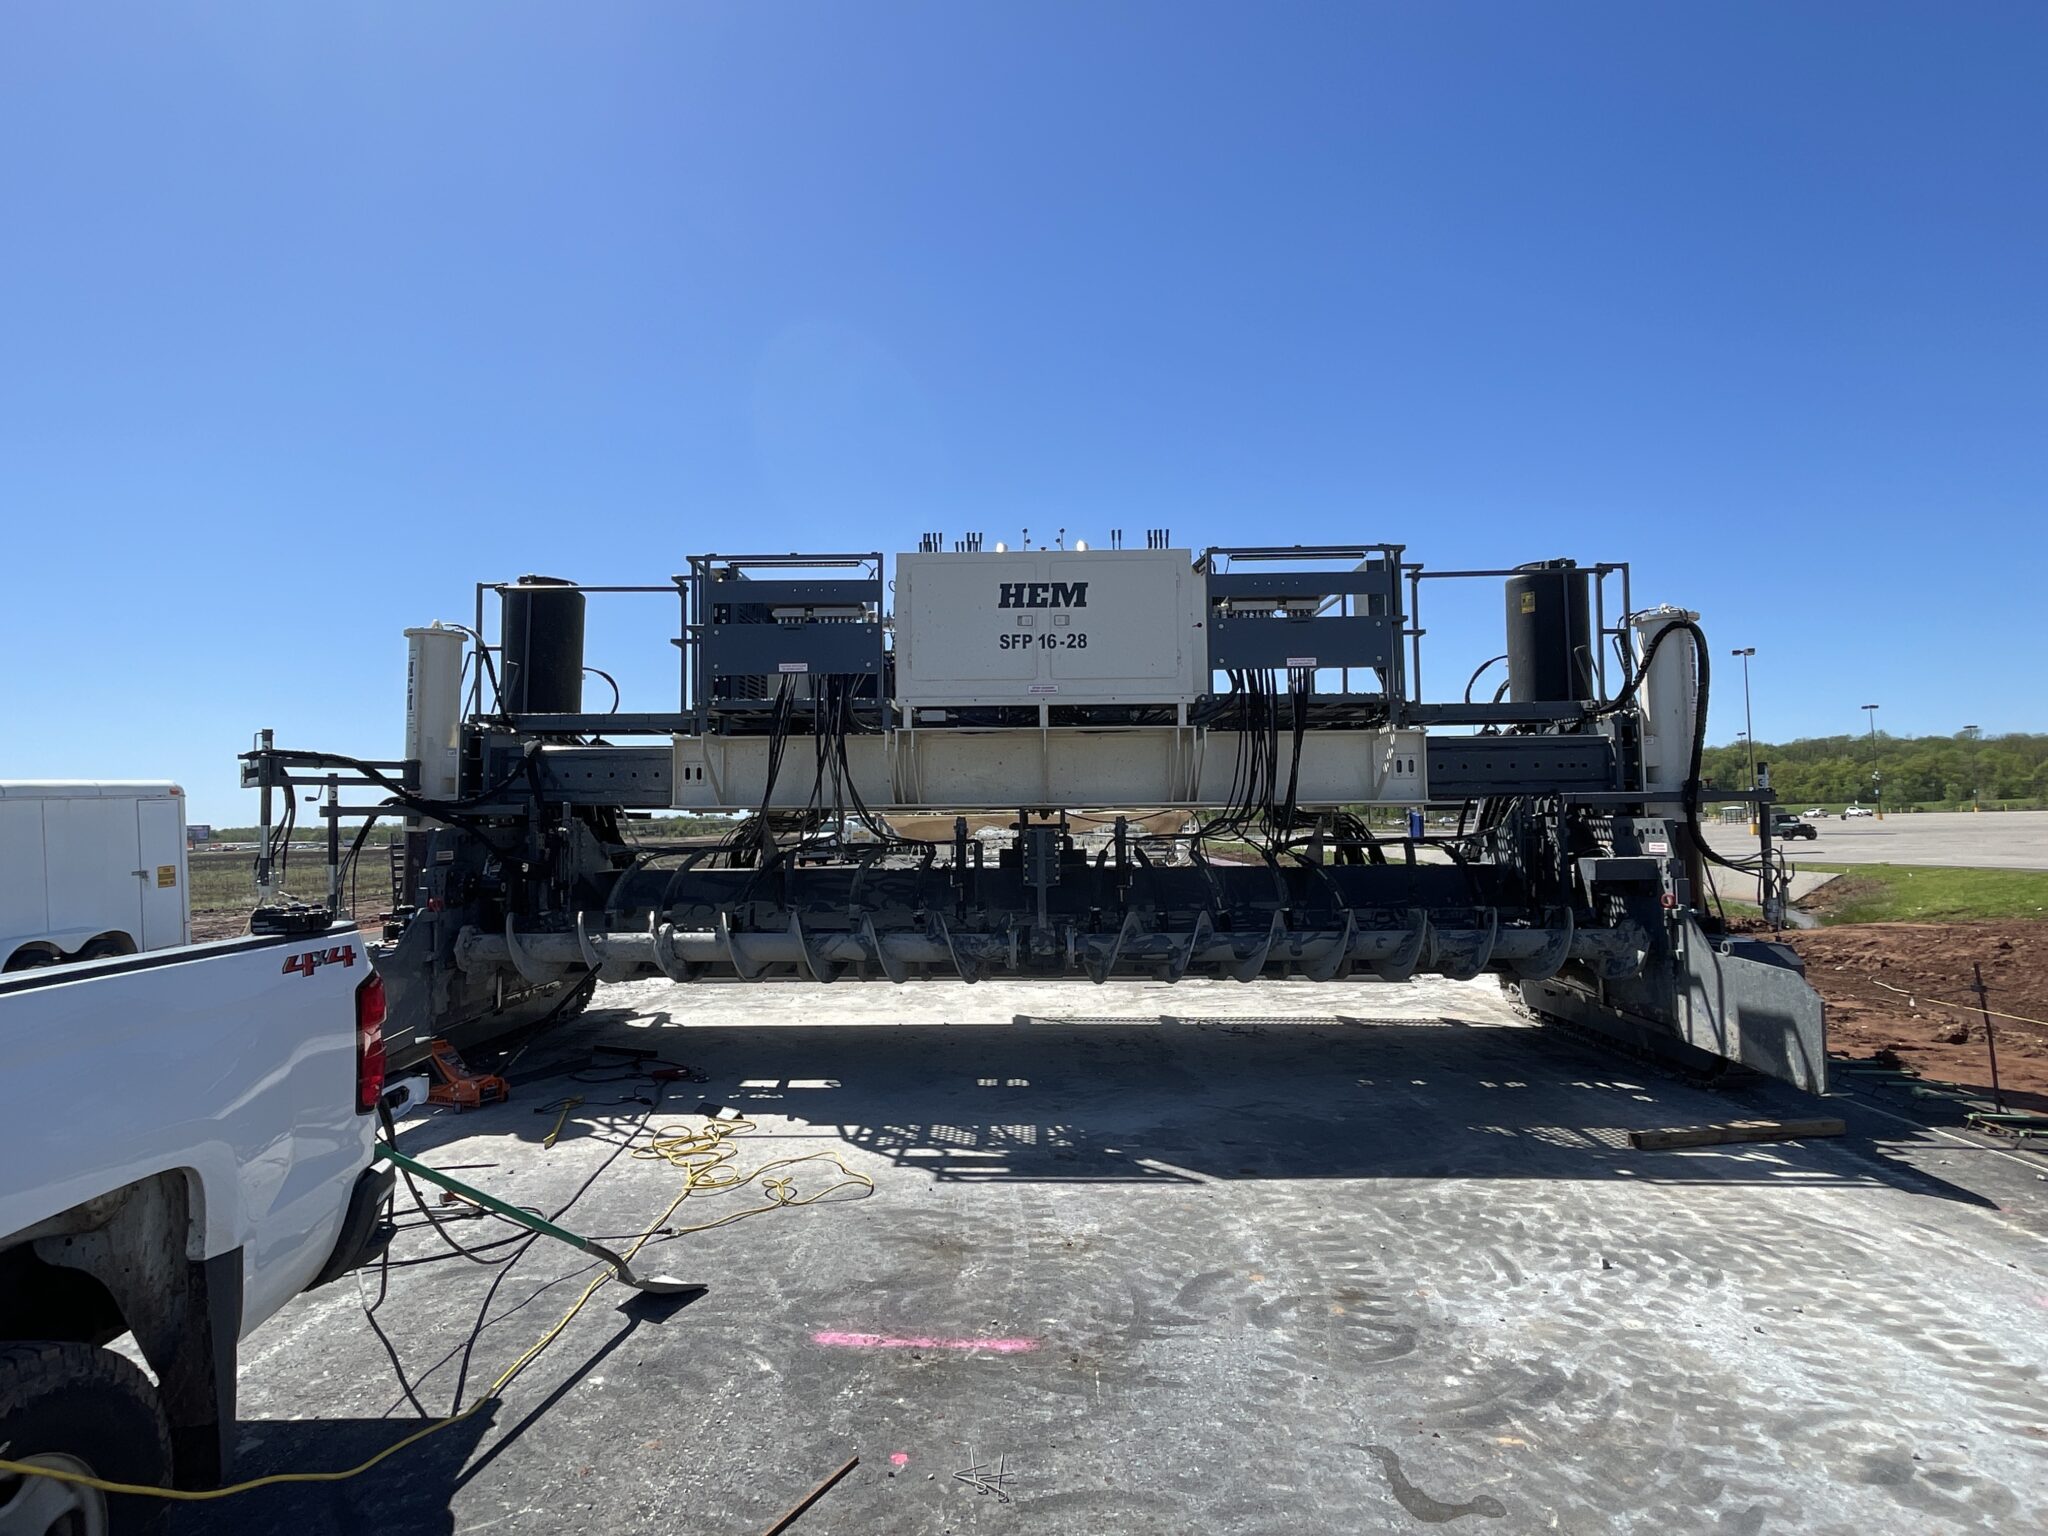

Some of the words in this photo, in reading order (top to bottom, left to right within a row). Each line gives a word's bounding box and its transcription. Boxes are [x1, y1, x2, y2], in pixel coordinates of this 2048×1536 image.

[998, 582, 1088, 608] HEM
[1000, 634, 1033, 649] SFP
[1038, 633, 1087, 649] 16-28
